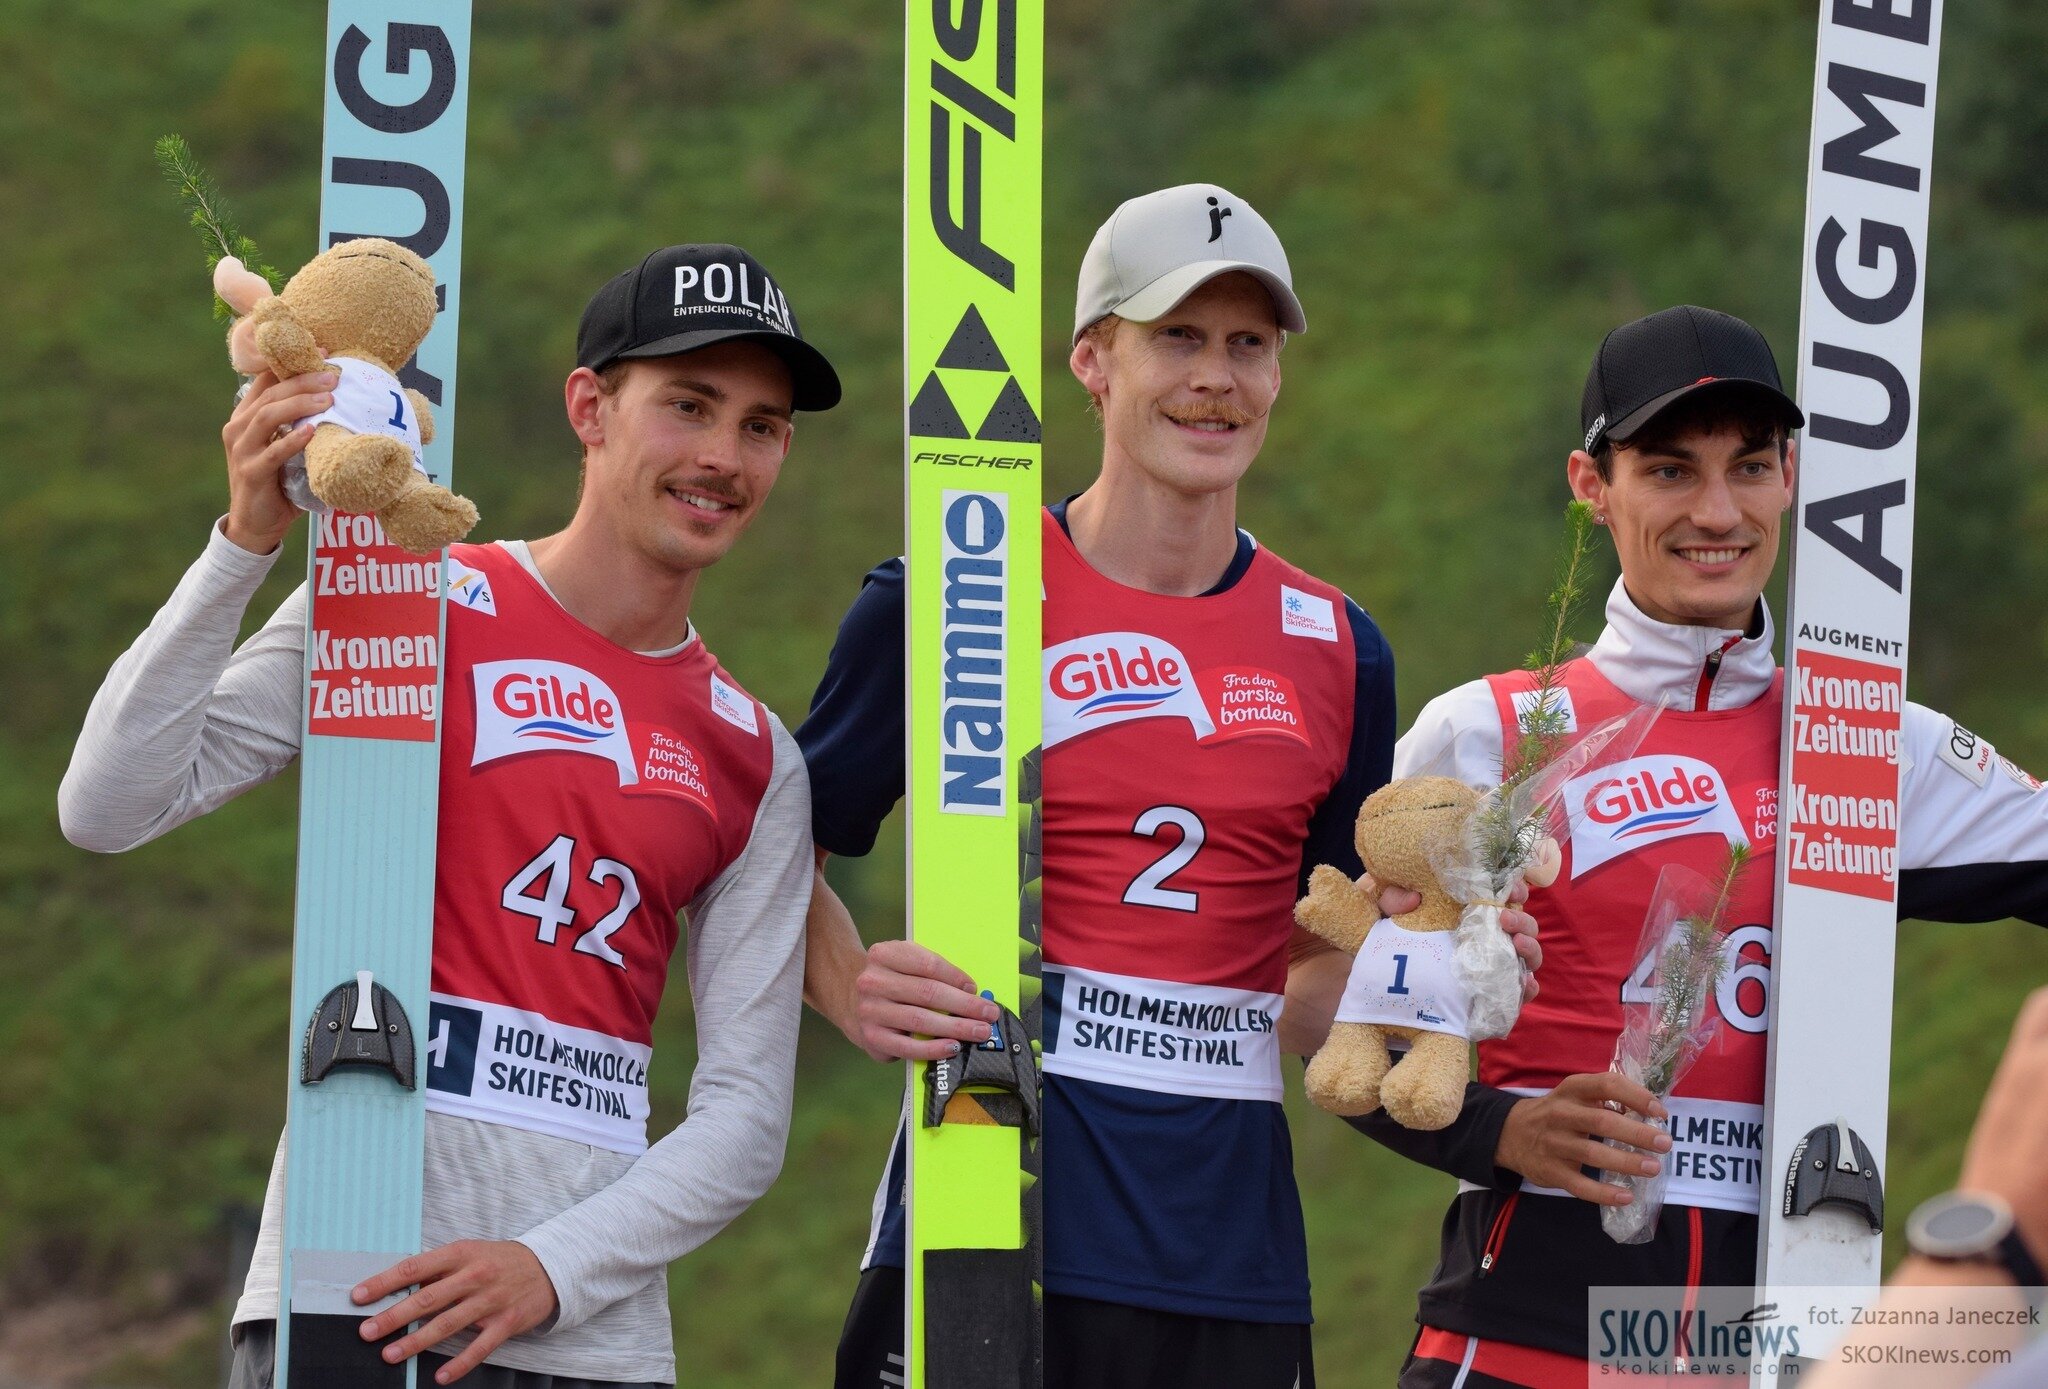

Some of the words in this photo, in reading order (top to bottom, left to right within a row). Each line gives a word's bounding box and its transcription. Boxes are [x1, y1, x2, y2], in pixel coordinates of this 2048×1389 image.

[674, 304, 753, 317] ENTFEUCHTUNG
[757, 312, 764, 322] &
[675, 263, 795, 337] POLAR
[389, 390, 407, 431] 1
[913, 452, 1033, 470] FISCHER
[316, 554, 441, 598] Zeitung
[1285, 611, 1316, 624] Norges
[1285, 617, 1333, 633] Skiforbund
[311, 630, 437, 671] Kronen
[944, 494, 1005, 811] Nammo
[1798, 623, 1902, 657] AUGMENT
[1050, 646, 1182, 700] Gilde
[1223, 673, 1250, 688] Fra
[1252, 673, 1277, 688] den
[1795, 666, 1899, 713] Kronen
[311, 677, 436, 721] Zeitung
[493, 673, 614, 728] Gilde
[1220, 704, 1297, 725] bonden
[1222, 687, 1287, 705] norske
[651, 732, 675, 748] Fra
[676, 740, 693, 759] den
[1795, 714, 1900, 764] Zeitung
[1977, 746, 1990, 772] Audi
[645, 761, 708, 797] bonden
[649, 747, 700, 776] norske
[1583, 767, 1718, 824] Gilde
[1790, 784, 1896, 830] Kronen
[1122, 805, 1206, 914] 2
[1790, 832, 1896, 882] Zeitung
[502, 834, 640, 972] 42
[1387, 954, 1409, 995] 1
[1619, 919, 1773, 1034] 46
[1074, 1020, 1244, 1066] SKIFESTIVAL
[488, 1062, 631, 1120] SKIFESTIVAL
[1784, 1138, 1808, 1214] slatnar.com
